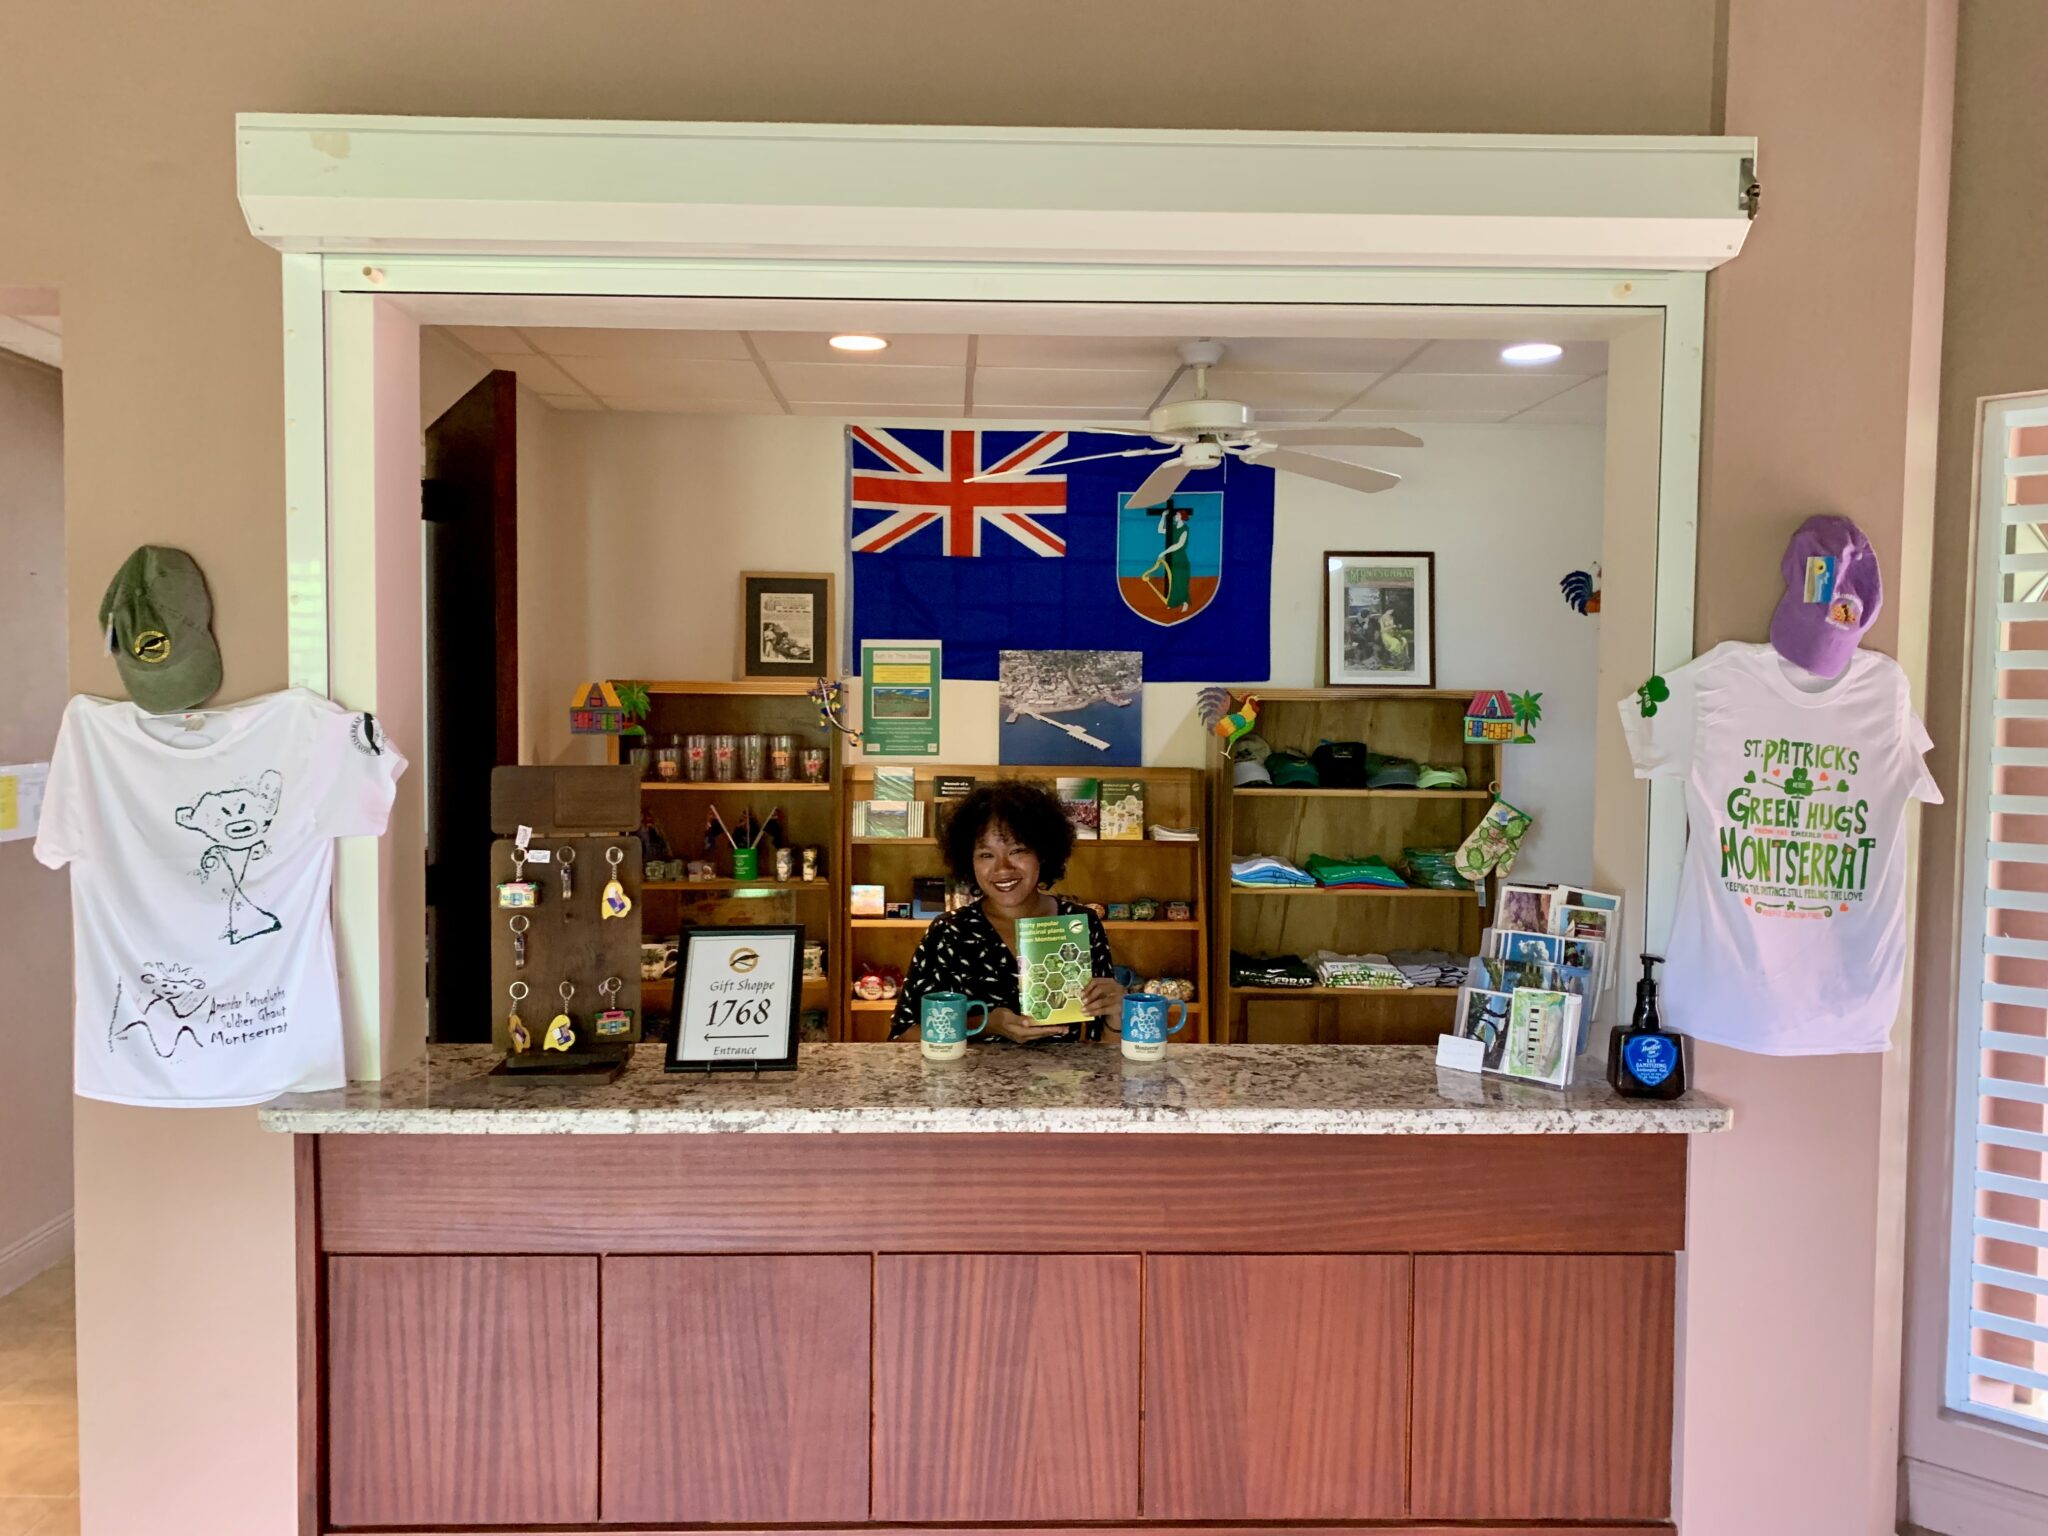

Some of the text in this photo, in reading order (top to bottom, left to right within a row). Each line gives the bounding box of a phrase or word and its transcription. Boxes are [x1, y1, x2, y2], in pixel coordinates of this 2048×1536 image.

[1727, 787, 1869, 837] GREEN HUGS
[1720, 827, 1876, 890] MONTSERRAT
[1843, 891, 1863, 901] LOVE
[1036, 921, 1059, 929] popular
[1047, 928, 1065, 936] plants
[710, 978, 775, 994] Gift Shoppe
[220, 1006, 286, 1028] Soldier Ghaut
[705, 998, 771, 1027] 1768
[210, 1022, 287, 1046] Montserrat
[713, 1046, 757, 1055] Entrance
